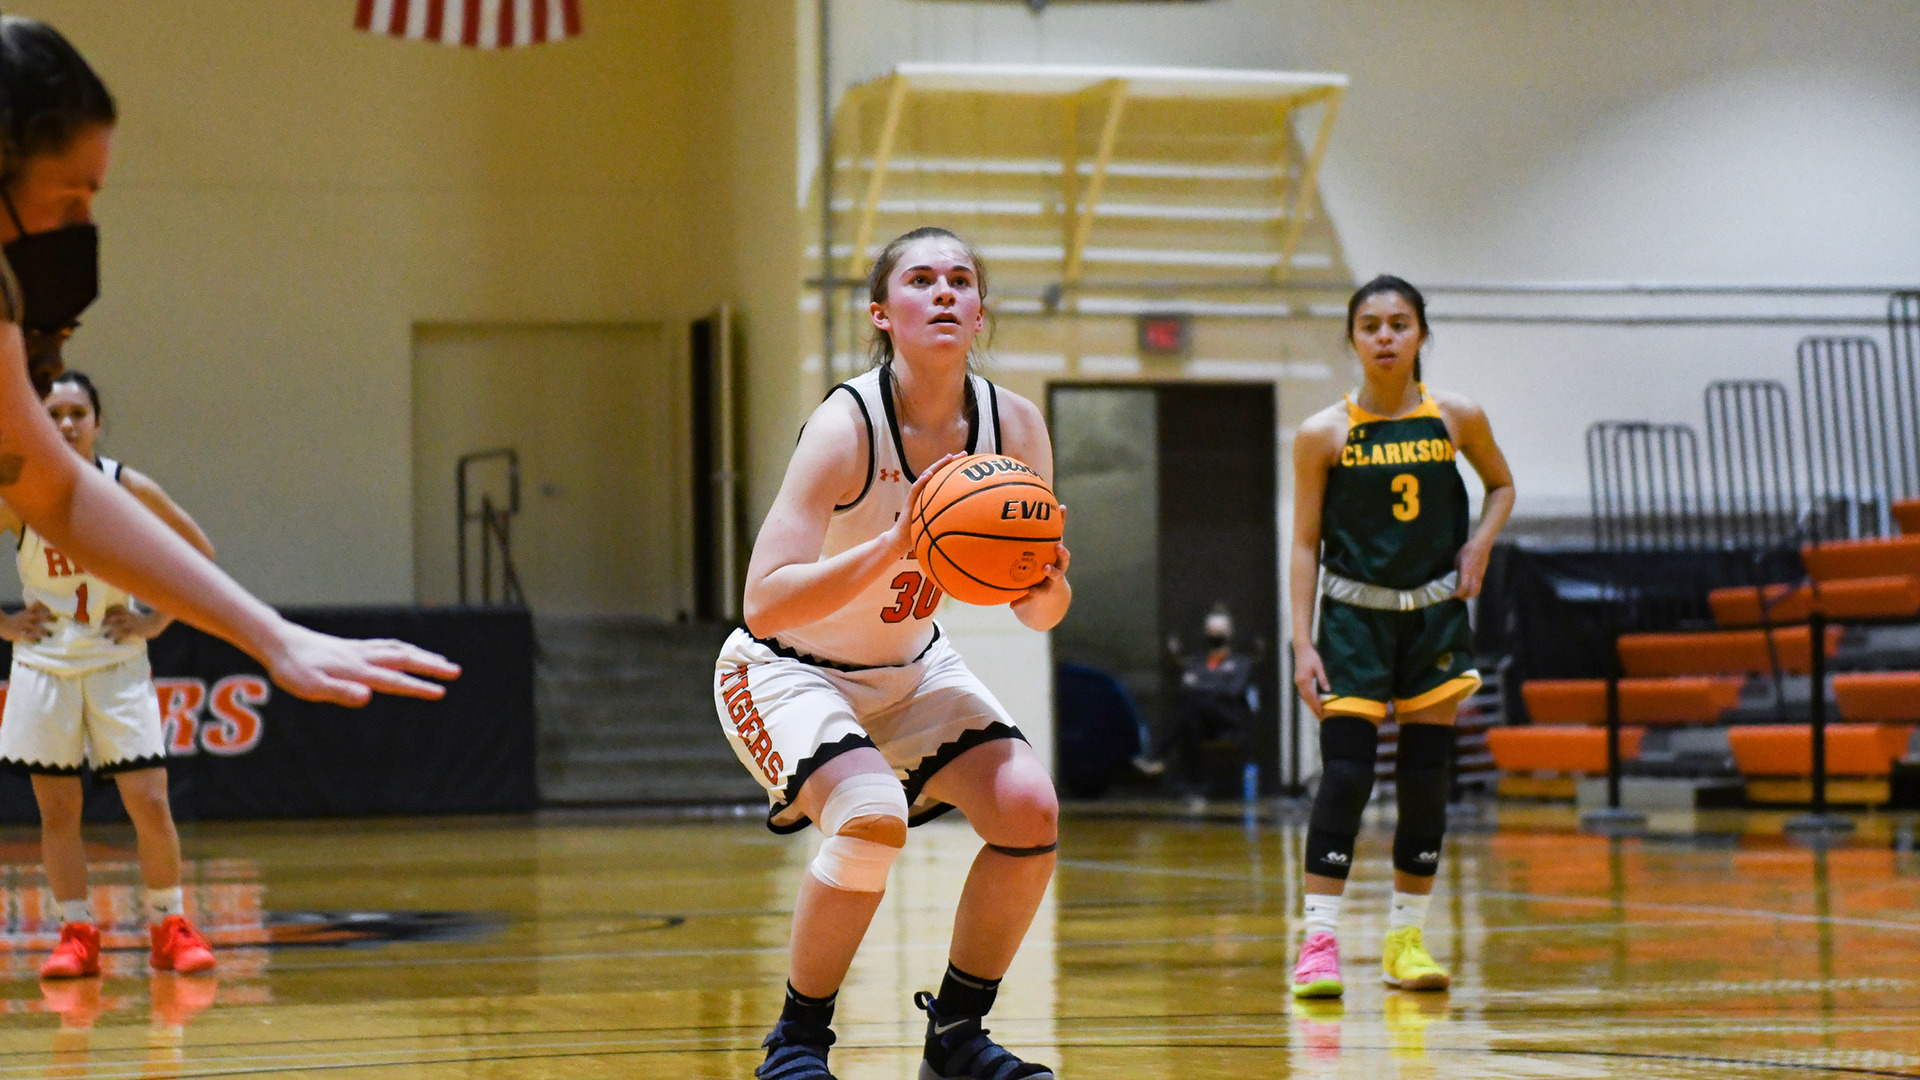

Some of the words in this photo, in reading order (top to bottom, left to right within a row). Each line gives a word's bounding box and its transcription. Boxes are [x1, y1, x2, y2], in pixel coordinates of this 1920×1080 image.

[1341, 439, 1456, 467] CLARKSON
[1001, 500, 1051, 520] EVO
[1391, 473, 1420, 522] 3
[74, 582, 90, 624] 1
[880, 571, 943, 623] 30
[720, 664, 784, 786] TIGERS
